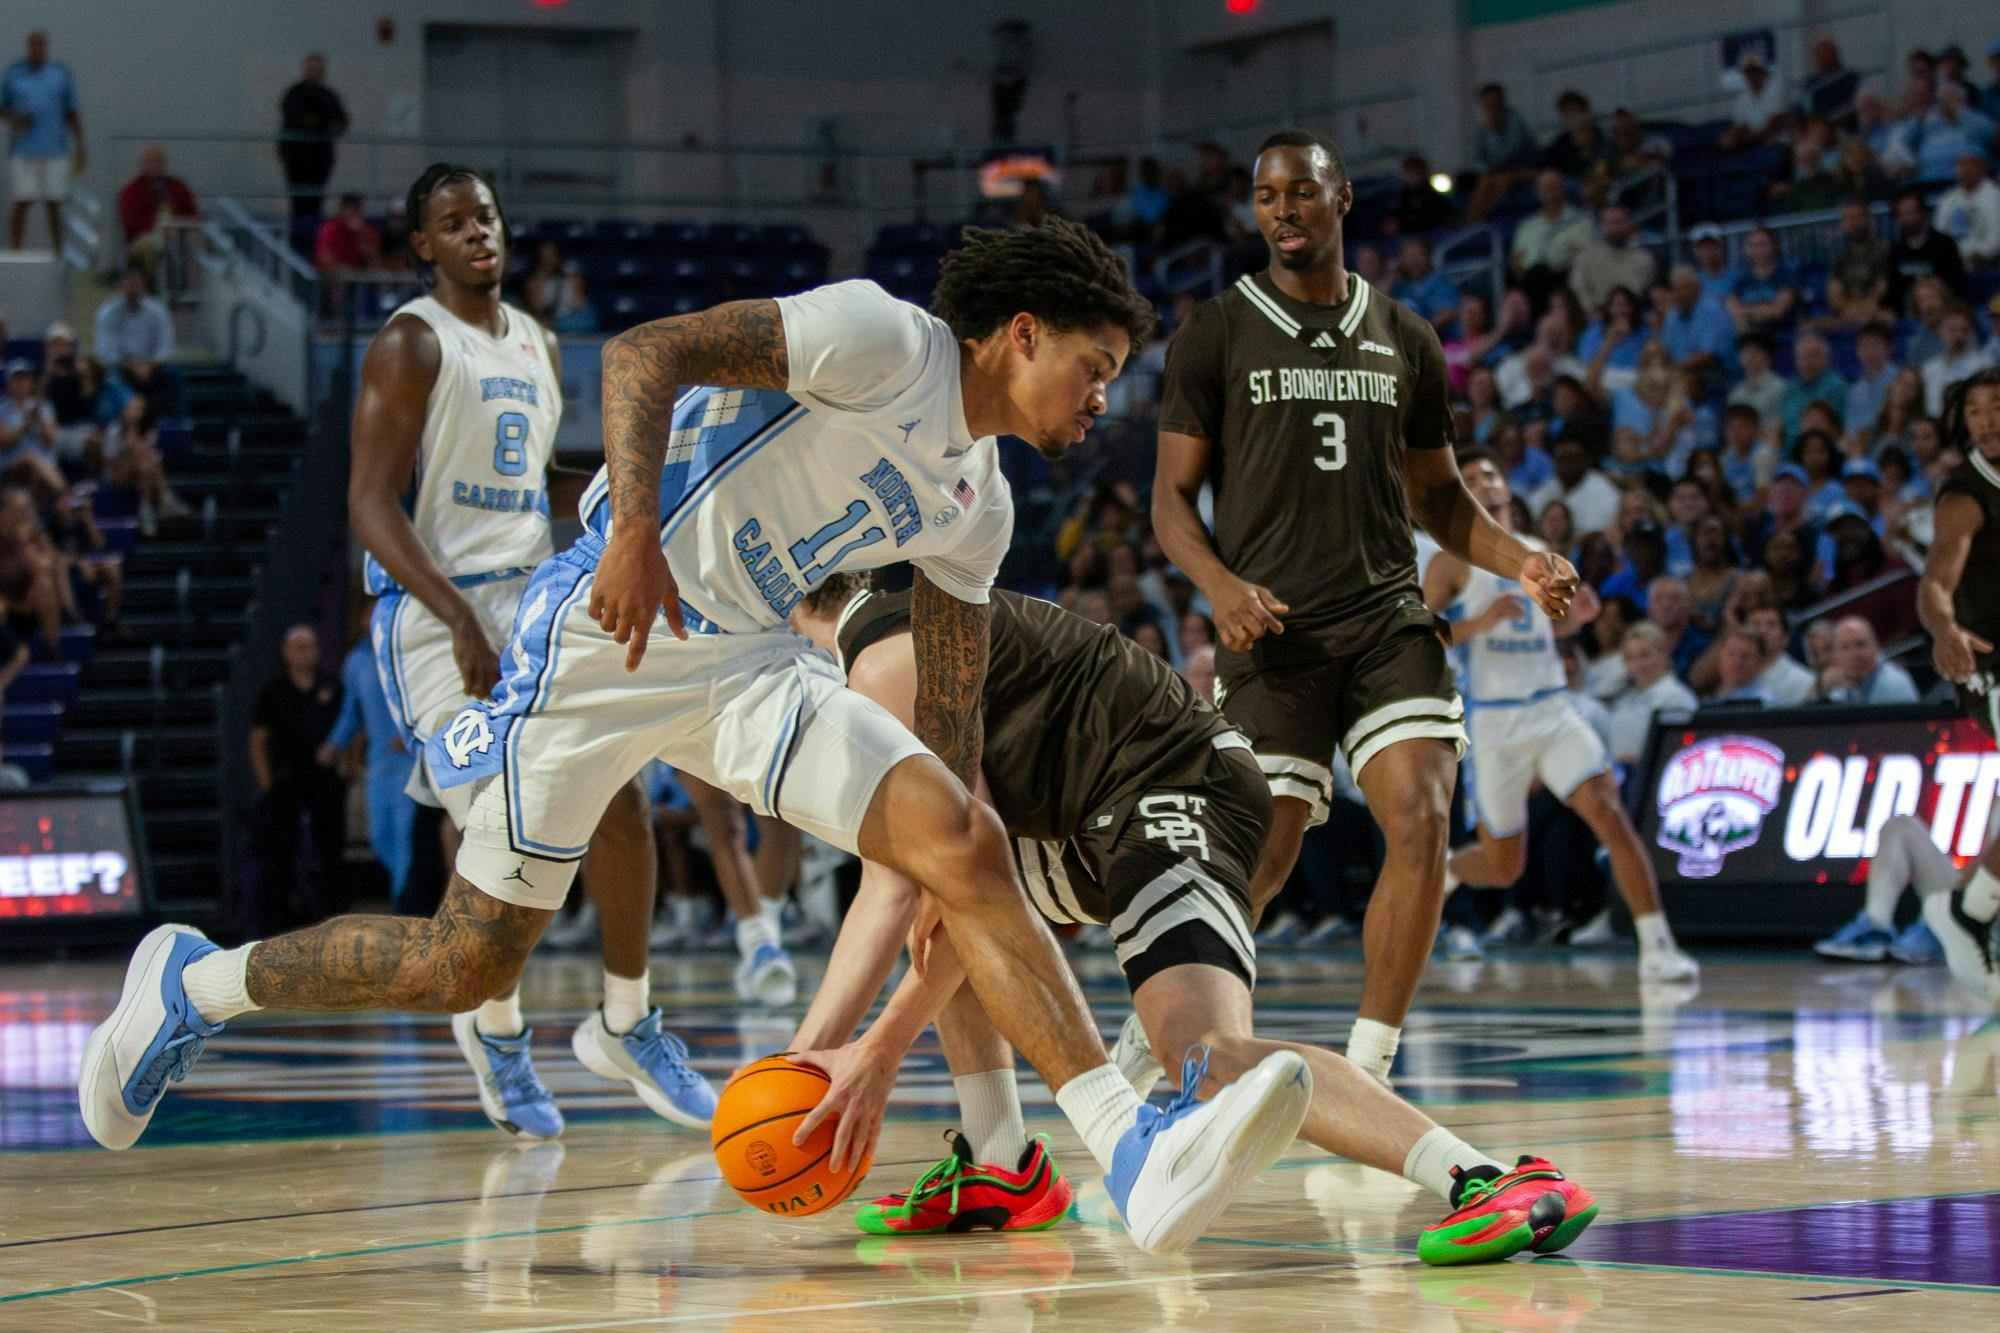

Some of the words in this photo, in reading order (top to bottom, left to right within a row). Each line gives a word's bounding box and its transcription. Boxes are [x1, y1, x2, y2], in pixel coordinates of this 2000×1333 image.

[1249, 370, 1278, 405] ST.
[1279, 368, 1398, 407] BONAVENTURE
[493, 411, 529, 477] 8
[1312, 412, 1347, 471] 3
[859, 457, 923, 548] NORTH
[788, 499, 887, 585] 11
[1784, 754, 1923, 861] OLD
